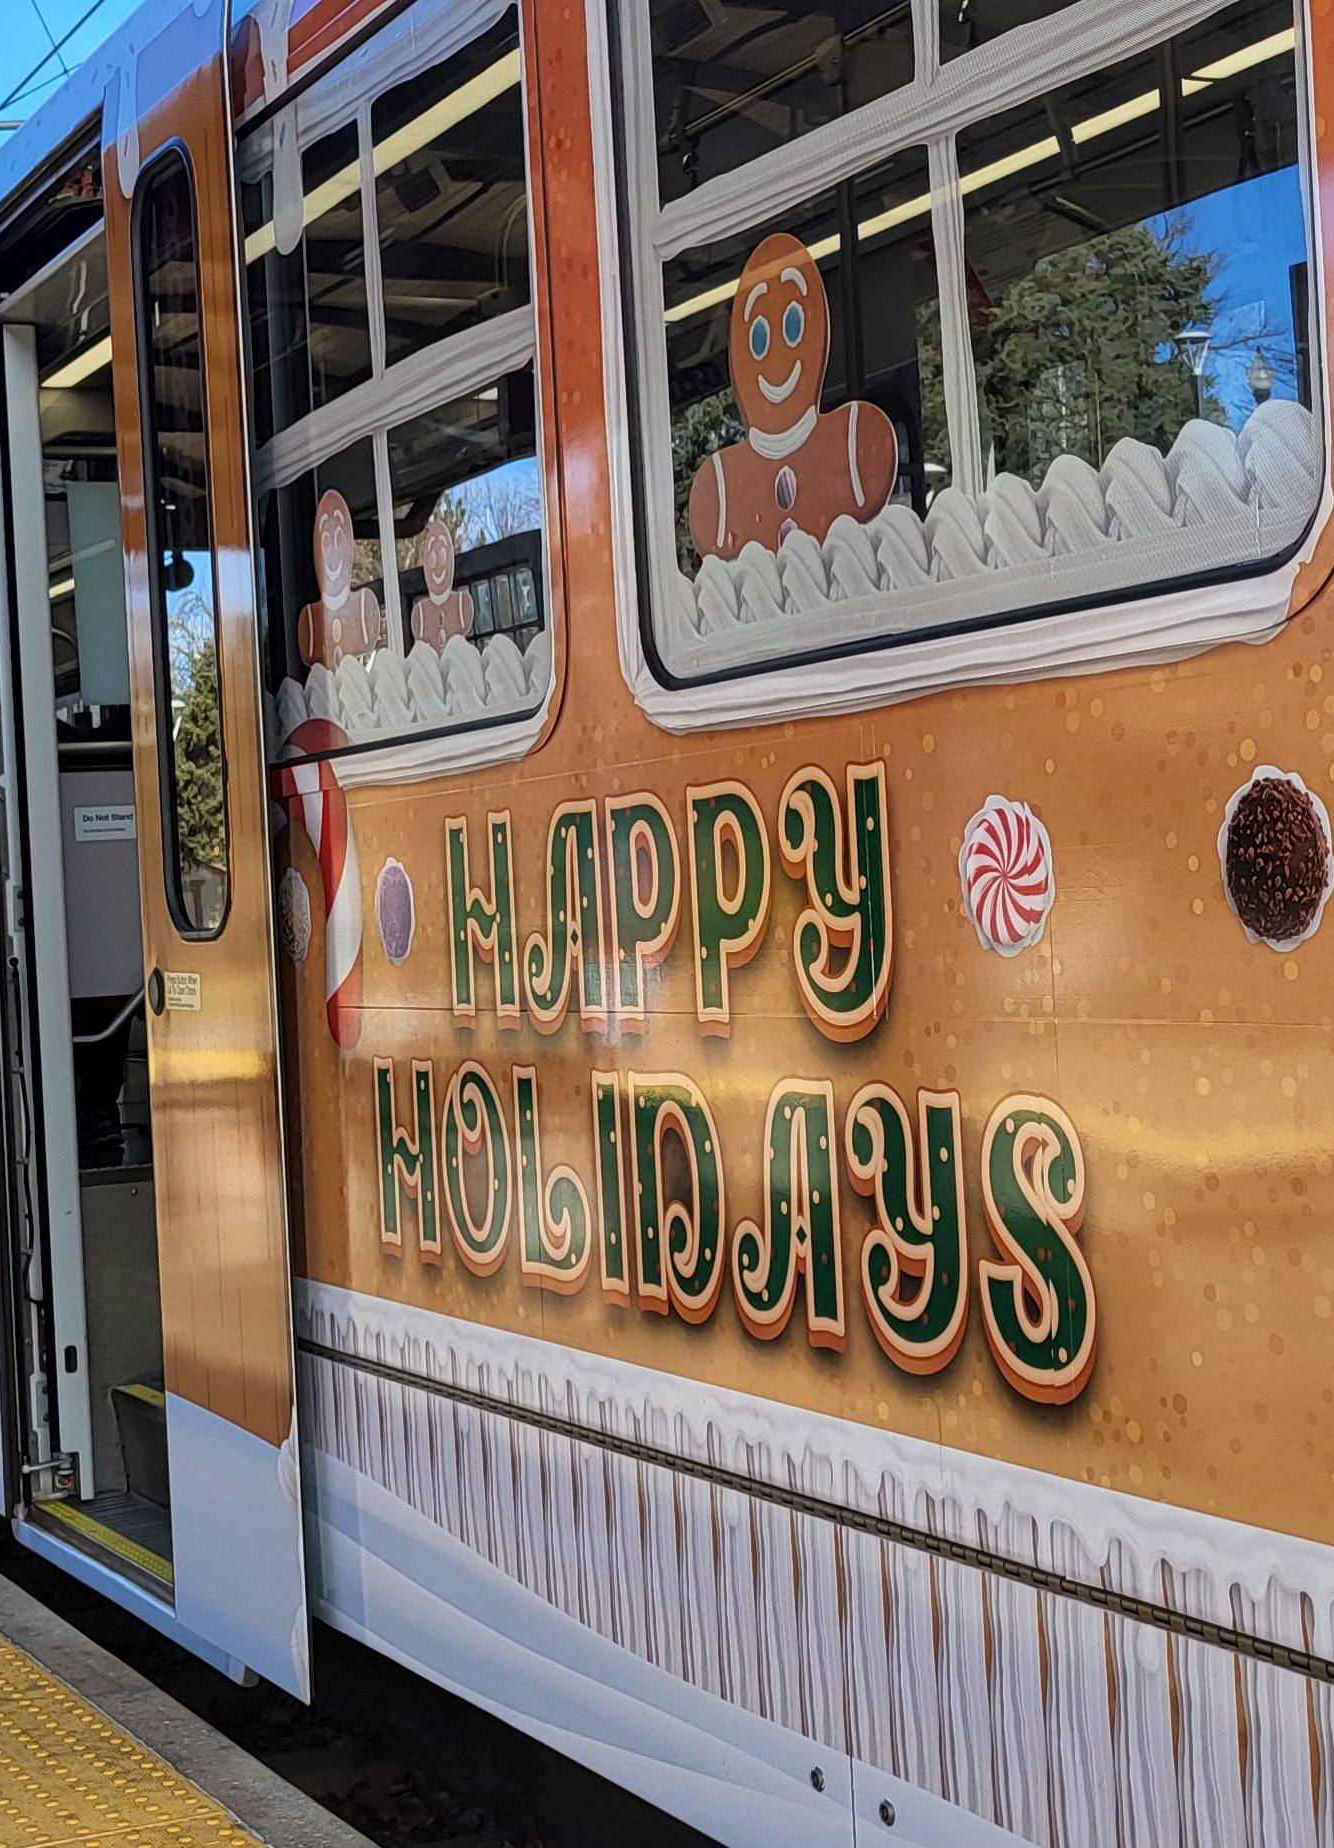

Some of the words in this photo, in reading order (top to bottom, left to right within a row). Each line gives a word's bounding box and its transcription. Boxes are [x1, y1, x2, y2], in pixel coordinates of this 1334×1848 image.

[82, 814, 94, 822] Do
[96, 813, 109, 822] Not
[442, 756, 894, 1043] HAPPY
[372, 1054, 1097, 1405] HOLIDAYS
